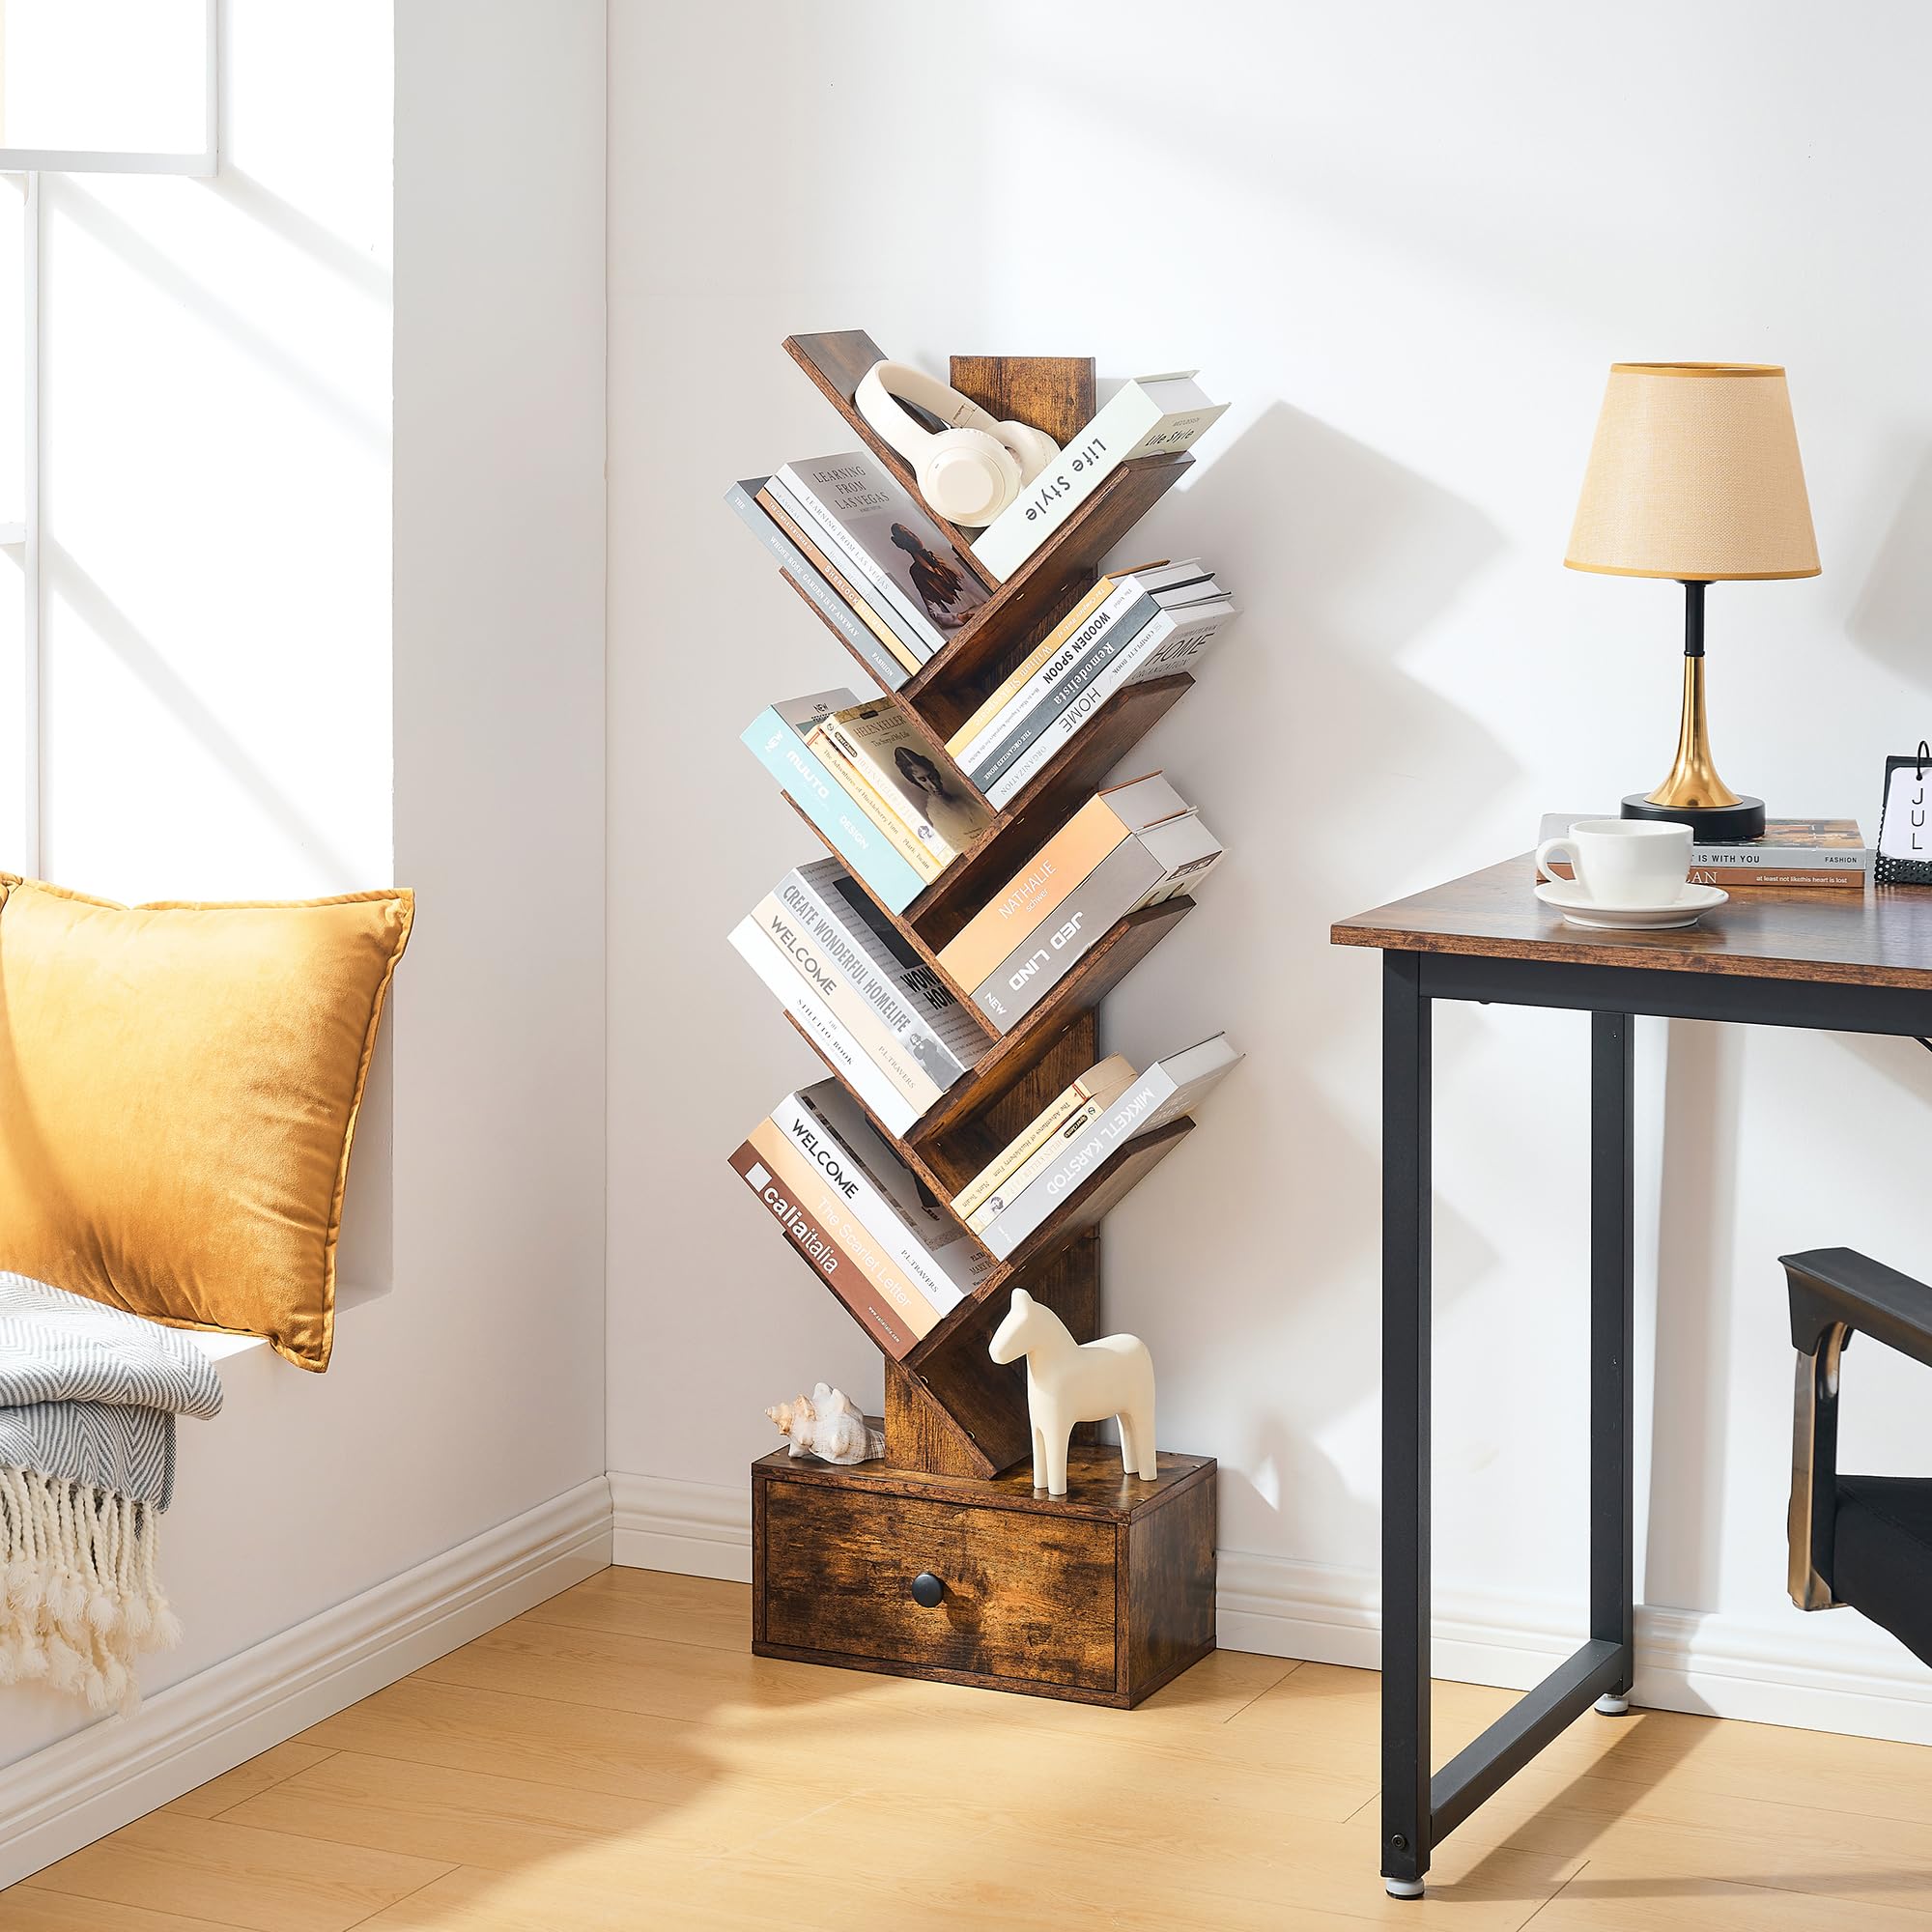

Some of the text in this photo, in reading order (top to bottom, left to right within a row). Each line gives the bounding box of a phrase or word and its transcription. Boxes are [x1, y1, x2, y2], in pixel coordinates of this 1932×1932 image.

[1145, 428, 1195, 447] Life Style
[812, 466, 866, 483] LEARNING
[837, 481, 867, 495] FROM
[1025, 437, 1107, 522] Life Style
[733, 497, 746, 510] THE
[835, 497, 860, 510] LAS
[856, 491, 890, 507] VEGAS
[804, 496, 890, 590] LEARNING FROM LAS VEGAS
[768, 536, 860, 638] WHOSE ROSE GARDEN IS IT ANYWAY
[823, 565, 887, 636] SHERLOCK HOLMES
[870, 651, 895, 676] FASHION
[1041, 611, 1110, 684] WOODEN SPOON
[1111, 629, 1154, 675] COMPLETE BOOK
[1144, 632, 1215, 667] HOME
[970, 642, 1052, 727] William Shakespeare
[1052, 640, 1115, 706] Remodelista
[853, 723, 881, 738] HELEN
[876, 715, 907, 731] KELLER
[1057, 686, 1101, 733] HOME
[982, 729, 1031, 780] THE ORGANIZED HOME
[999, 745, 1047, 795] ORGANIZATION
[822, 749, 834, 760] The
[831, 758, 856, 786] Adventures
[886, 821, 899, 835] Finn
[838, 814, 870, 849] DESIGN
[1911, 788, 1925, 850] JUL
[901, 838, 930, 869] Mark Twain
[1698, 854, 1708, 863] IS
[1712, 854, 1736, 863] WITH
[1740, 855, 1760, 864] YOU
[996, 858, 1057, 920] NATHALIE
[1024, 887, 1049, 913] schwer
[767, 915, 838, 996] WELCOME
[781, 883, 819, 925] CREATE
[810, 918, 868, 984] WONDERFUL
[861, 977, 911, 1033] HOMELIFE
[1007, 909, 1088, 991] JED LIND
[982, 991, 1007, 1016] NEW
[795, 998, 832, 1039] STILETTO
[831, 1039, 854, 1065] BOOK
[876, 1044, 916, 1090] P.L.TRAVERS
[1035, 1110, 1061, 1135] Adventures
[1059, 1101, 1070, 1113] The
[1099, 1086, 1155, 1144] MIKKETL
[788, 1118, 860, 1199] WELCOME
[992, 1165, 1005, 1178] Finn
[1002, 1139, 1032, 1168] Huckleberry
[1043, 1137, 1103, 1196] KARSTOD
[961, 1179, 989, 1208] Mark Twain
[759, 1181, 842, 1275] caliaitalia
[814, 1195, 914, 1310] The Scarlet Letter
[899, 1248, 940, 1293] P.L.TRAVERS
